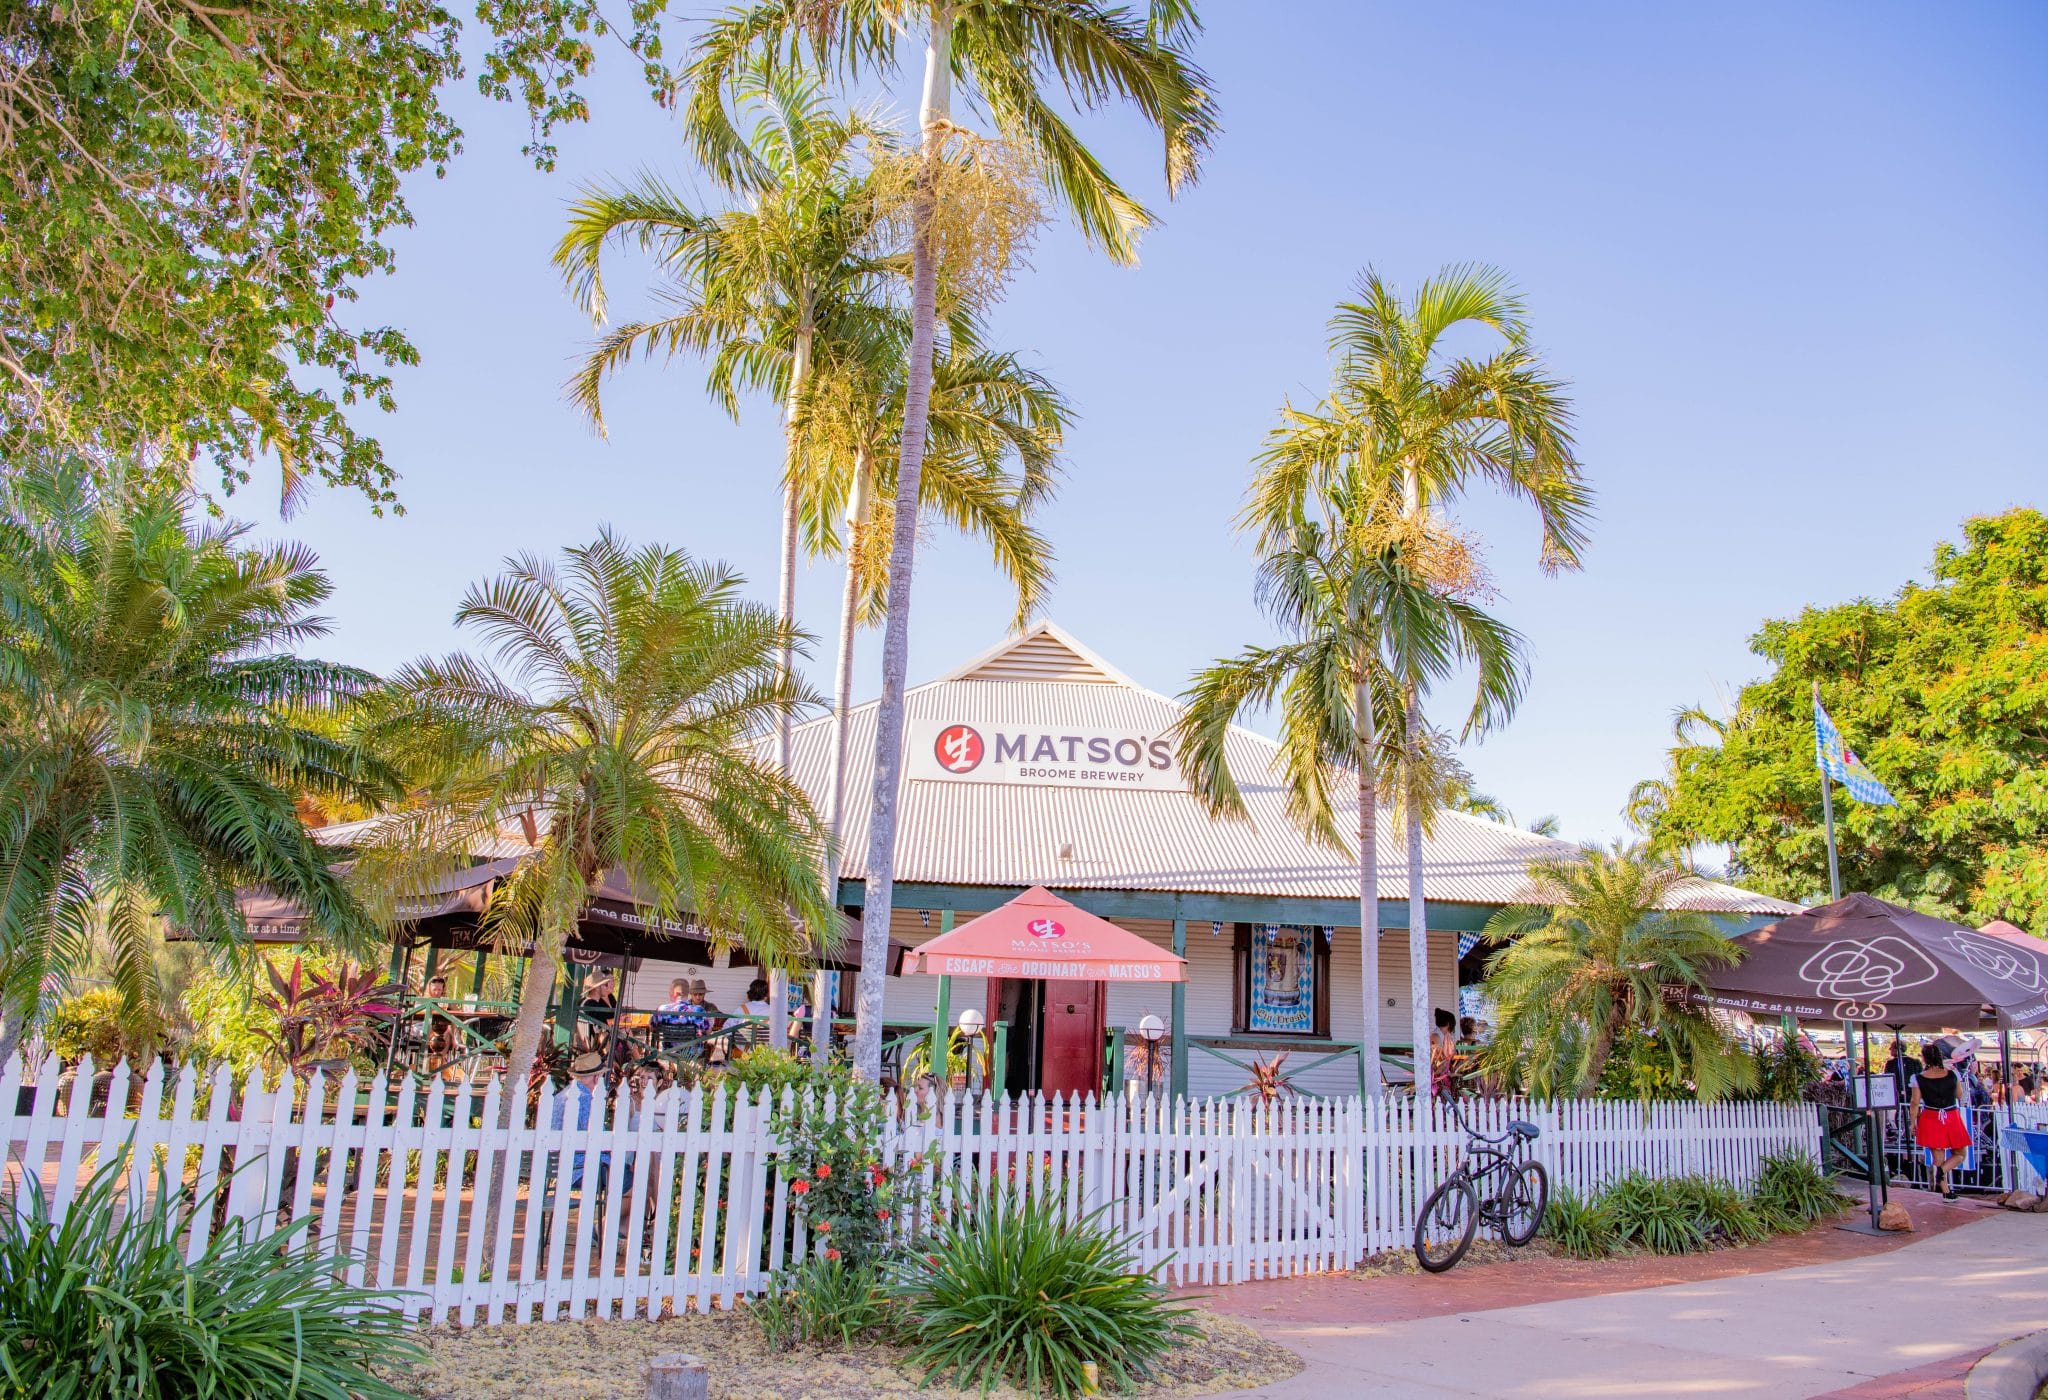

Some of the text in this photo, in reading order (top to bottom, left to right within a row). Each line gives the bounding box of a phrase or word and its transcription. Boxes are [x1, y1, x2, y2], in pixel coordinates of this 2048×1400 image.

[994, 732, 1172, 770] MATSO'S
[1020, 767, 1145, 782] BROOME BREWERY
[261, 924, 271, 934] at
[946, 957, 995, 974] ESCAPE
[1021, 961, 1087, 977] ORDINARY
[1109, 964, 1162, 978] MATSO'S
[1661, 986, 1684, 995] FIX
[1716, 997, 1749, 1007] small
[1750, 1000, 1768, 1010] fix
[1769, 1003, 1783, 1011] at
[1795, 1005, 1823, 1015] time
